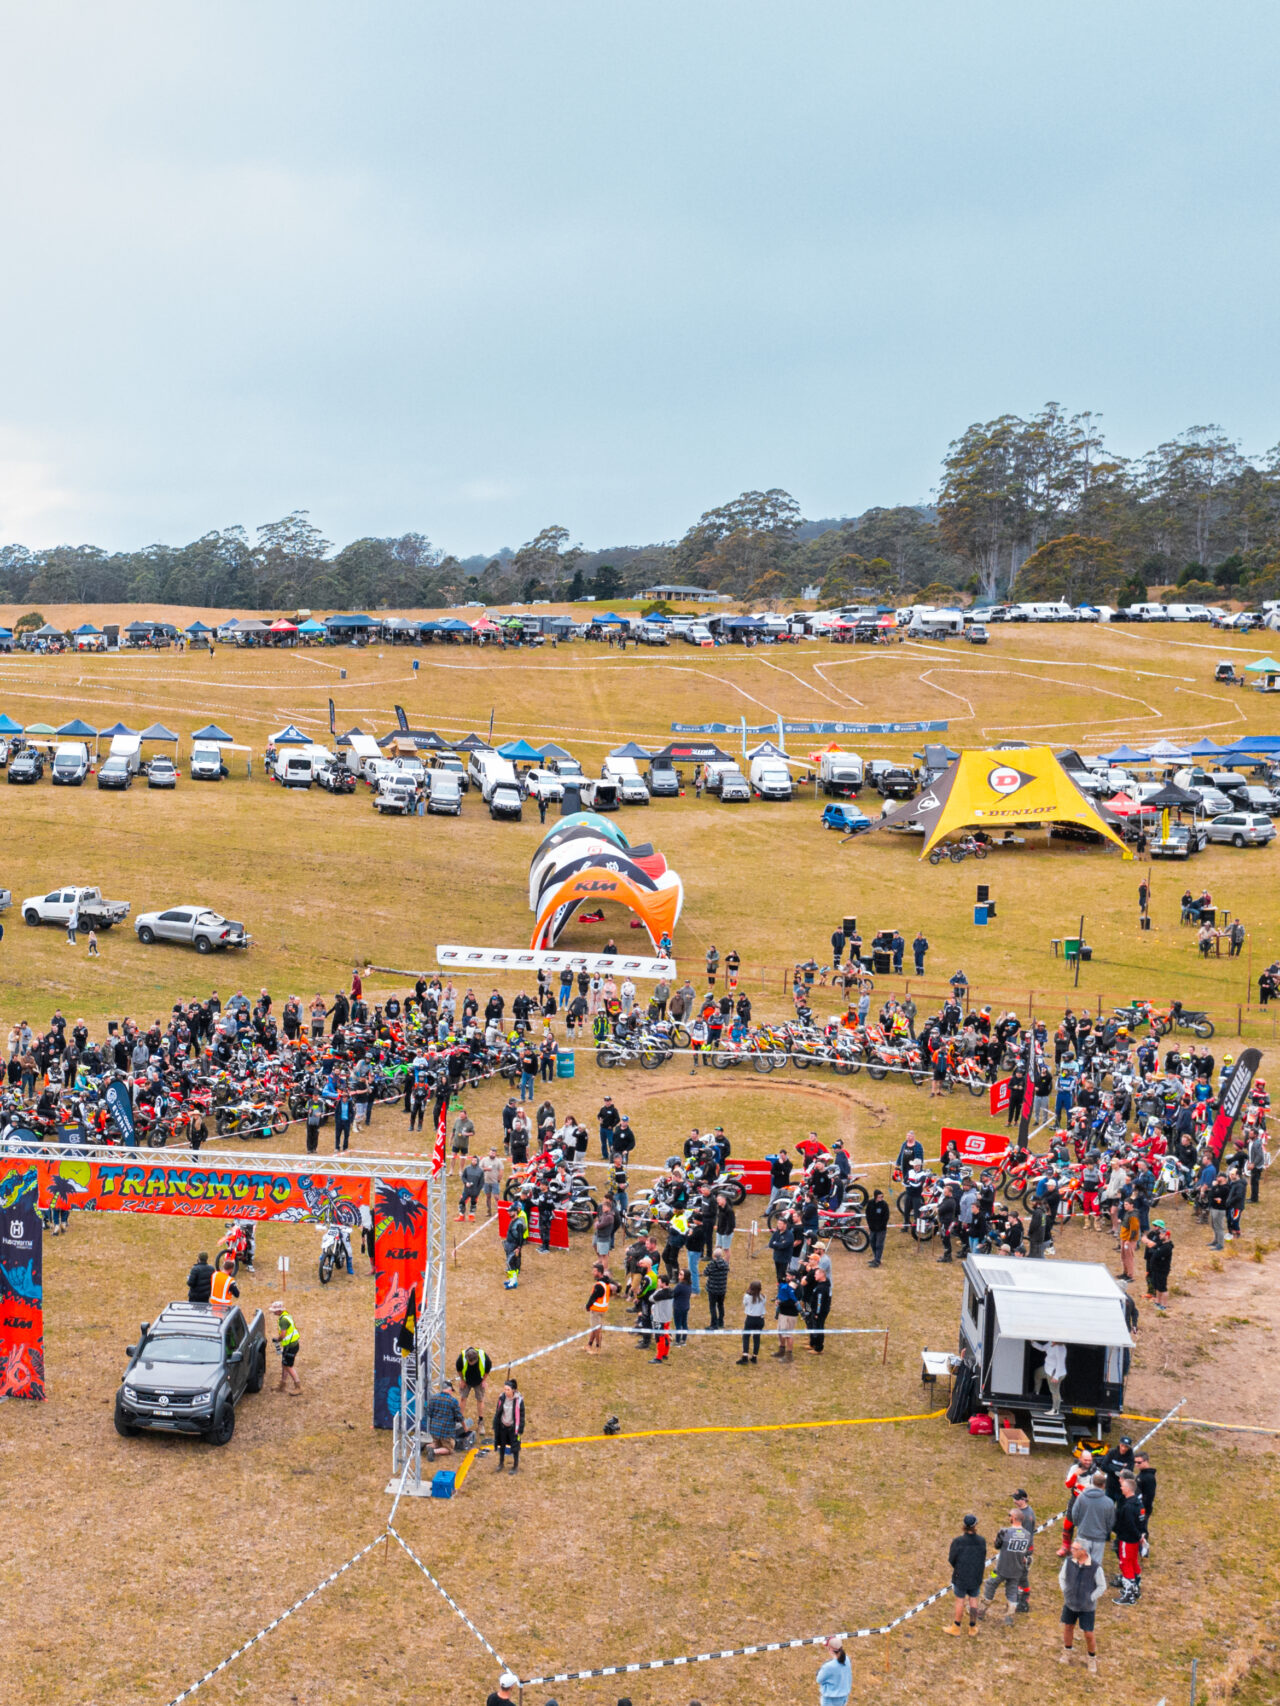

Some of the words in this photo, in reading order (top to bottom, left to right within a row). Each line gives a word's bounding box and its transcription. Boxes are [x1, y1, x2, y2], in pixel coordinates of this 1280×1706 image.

[987, 805, 1057, 817] DUNLOP
[573, 879, 618, 892] KTM
[97, 1165, 292, 1203] TRANSMOTO
[120, 1199, 163, 1213] RACE
[171, 1200, 217, 1215] YOUR
[223, 1204, 268, 1218] MATES
[385, 1247, 419, 1260] KTM
[3, 1315, 33, 1329] KTM
[1007, 1538, 1029, 1553] 108
